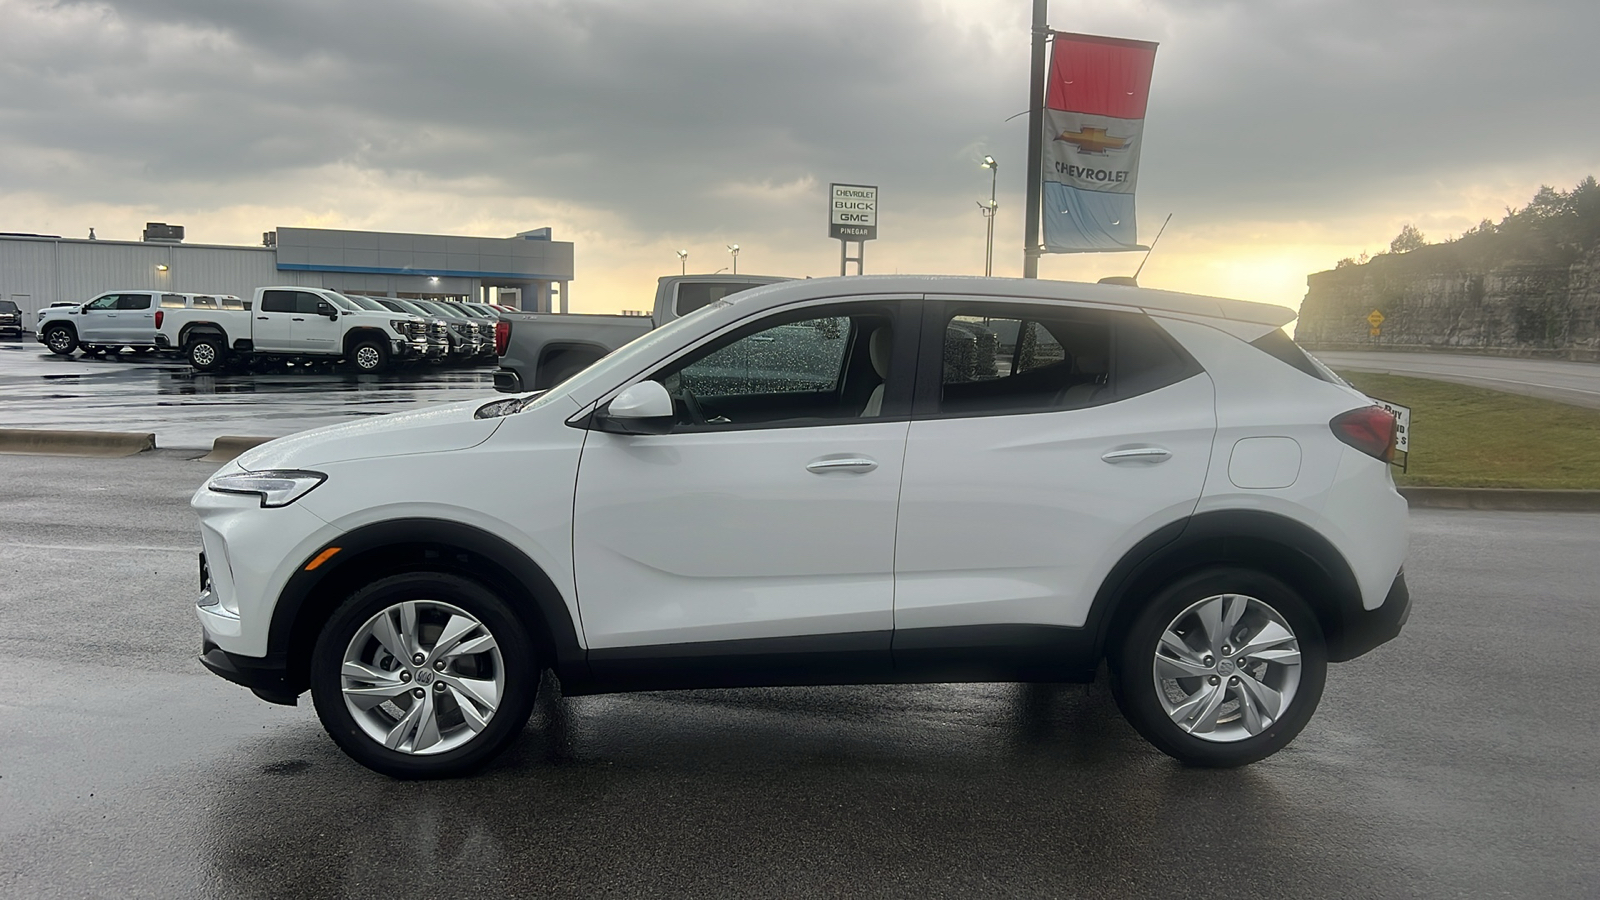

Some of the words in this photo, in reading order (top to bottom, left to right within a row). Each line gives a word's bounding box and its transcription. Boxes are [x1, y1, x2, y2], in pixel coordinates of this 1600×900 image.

[1055, 161, 1129, 182] CHEVROLET
[836, 189, 874, 198] CHEVROLET
[835, 201, 874, 210] BUICK
[840, 213, 869, 222] GMC
[840, 227, 868, 235] PINEGAR
